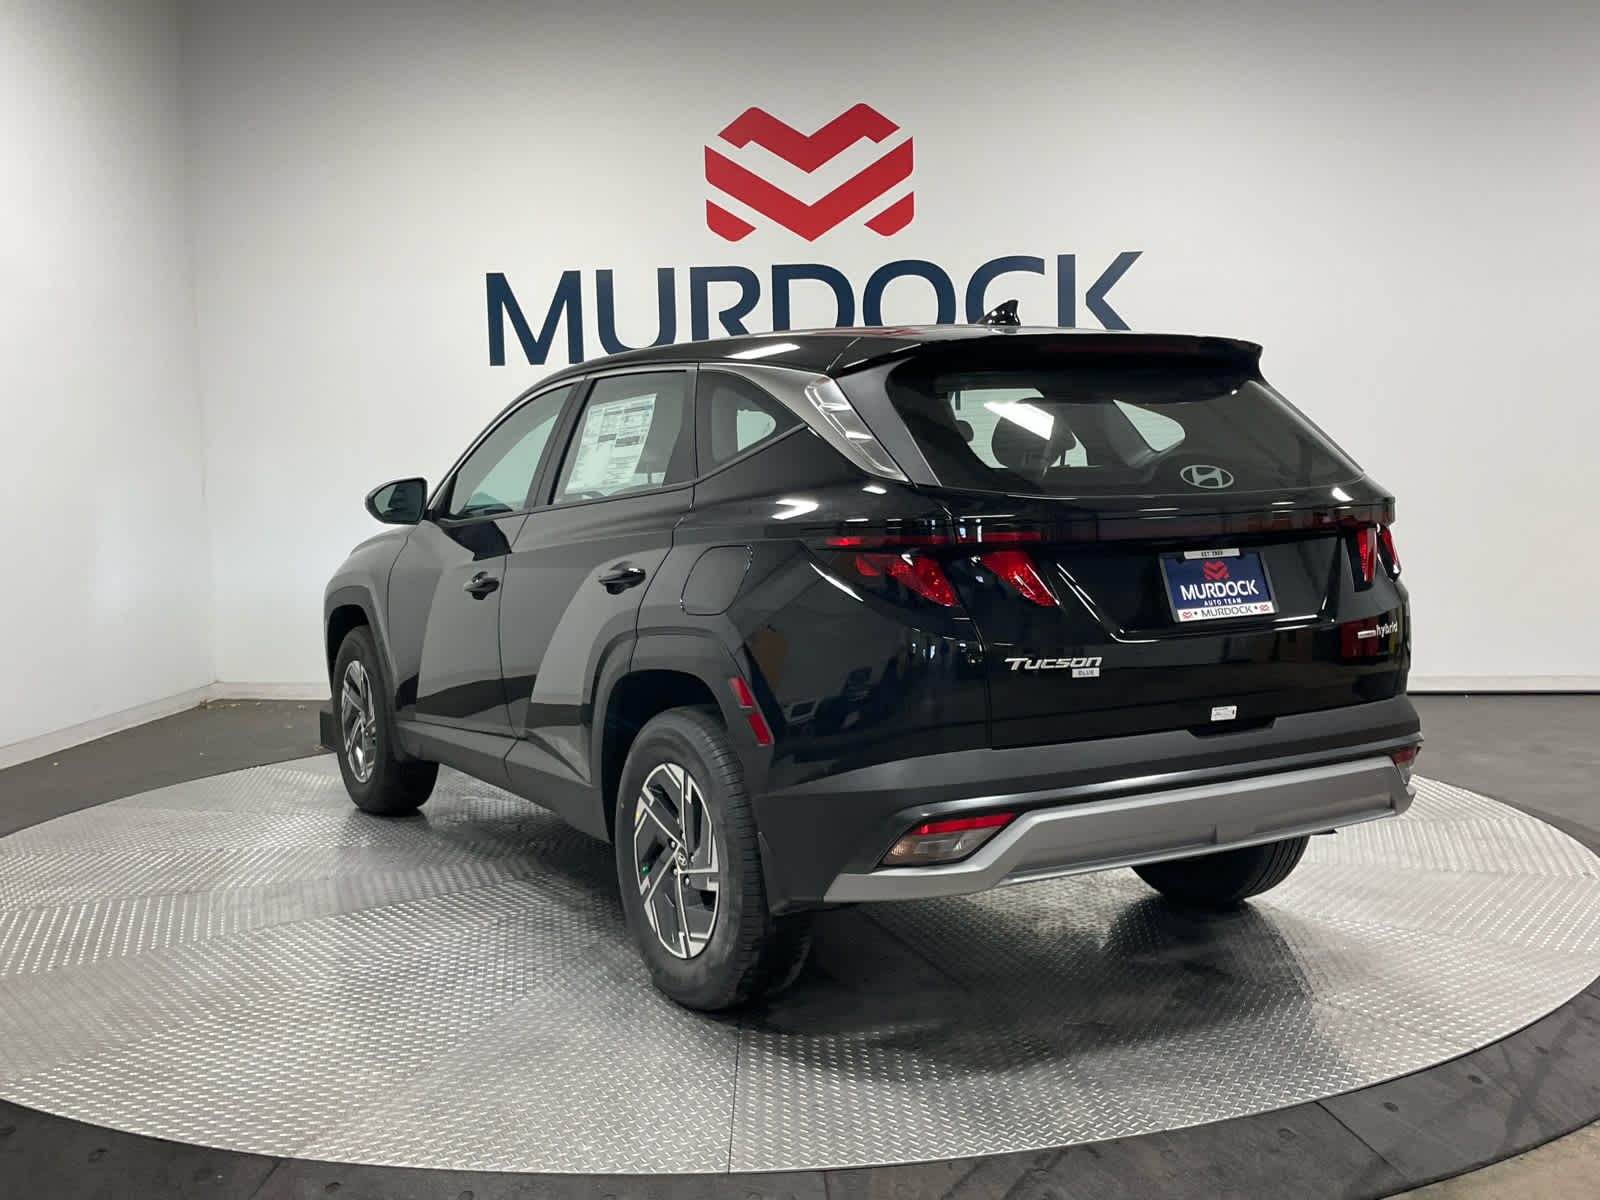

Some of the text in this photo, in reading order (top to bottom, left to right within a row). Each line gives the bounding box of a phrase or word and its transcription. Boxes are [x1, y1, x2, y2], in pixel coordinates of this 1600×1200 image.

[485, 251, 1144, 366] MURDOCK
[1179, 579, 1259, 601] MURDOCK
[1223, 597, 1242, 605] TEAM
[1201, 605, 1253, 618] MURDOCK
[1375, 620, 1398, 638] hybrid
